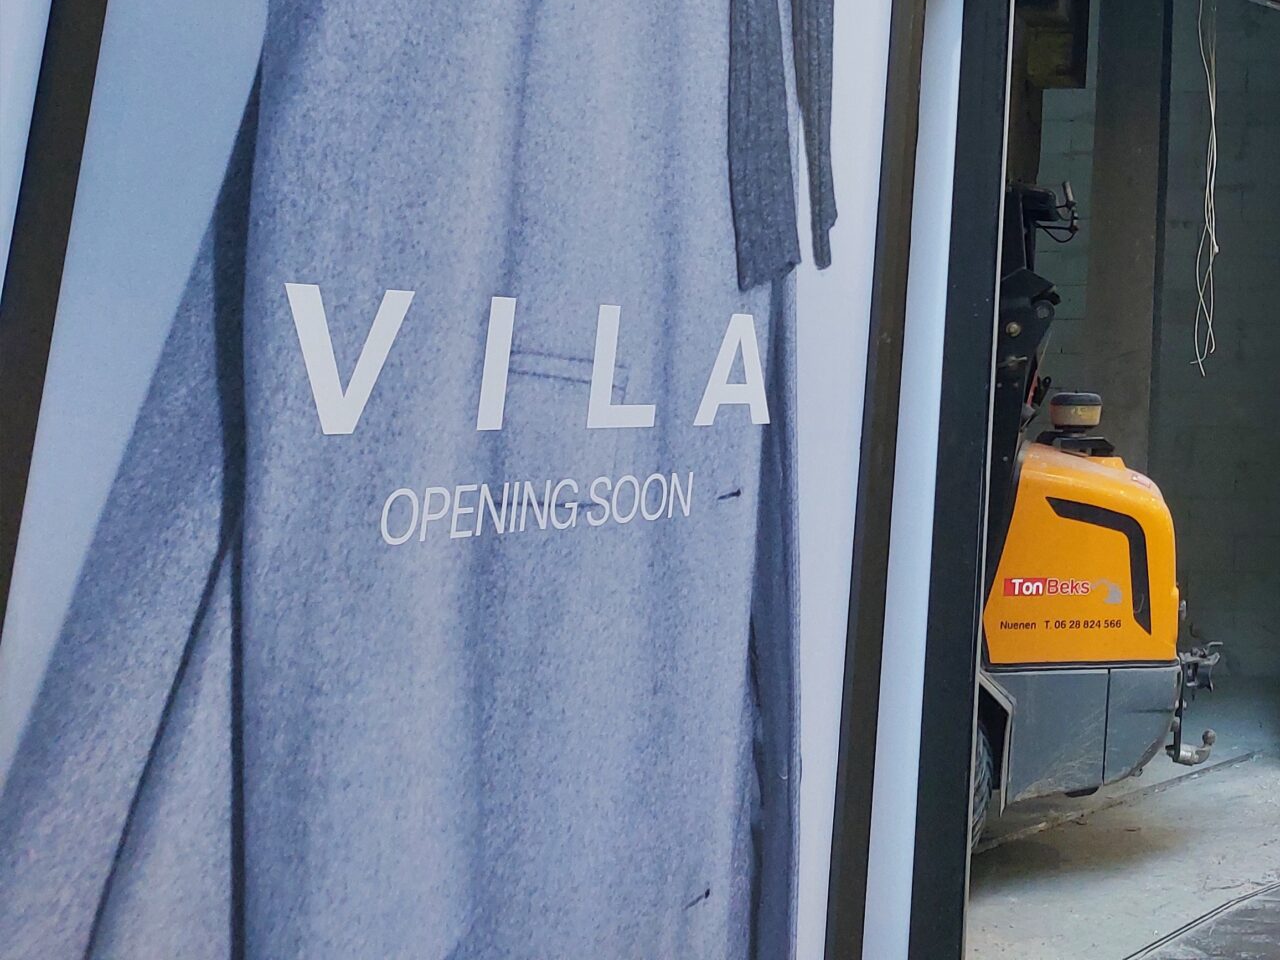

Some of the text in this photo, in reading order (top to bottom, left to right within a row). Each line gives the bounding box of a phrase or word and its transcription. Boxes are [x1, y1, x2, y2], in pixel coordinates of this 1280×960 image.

[284, 282, 770, 435] VILA
[380, 471, 695, 546] OPENING SOON
[1011, 578, 1090, 596] Ton Beks
[1000, 620, 1037, 630] Nuenen
[1054, 620, 1066, 629] 06
[1069, 620, 1081, 629] 28
[1083, 620, 1101, 629] 824
[1104, 619, 1122, 629] 566
